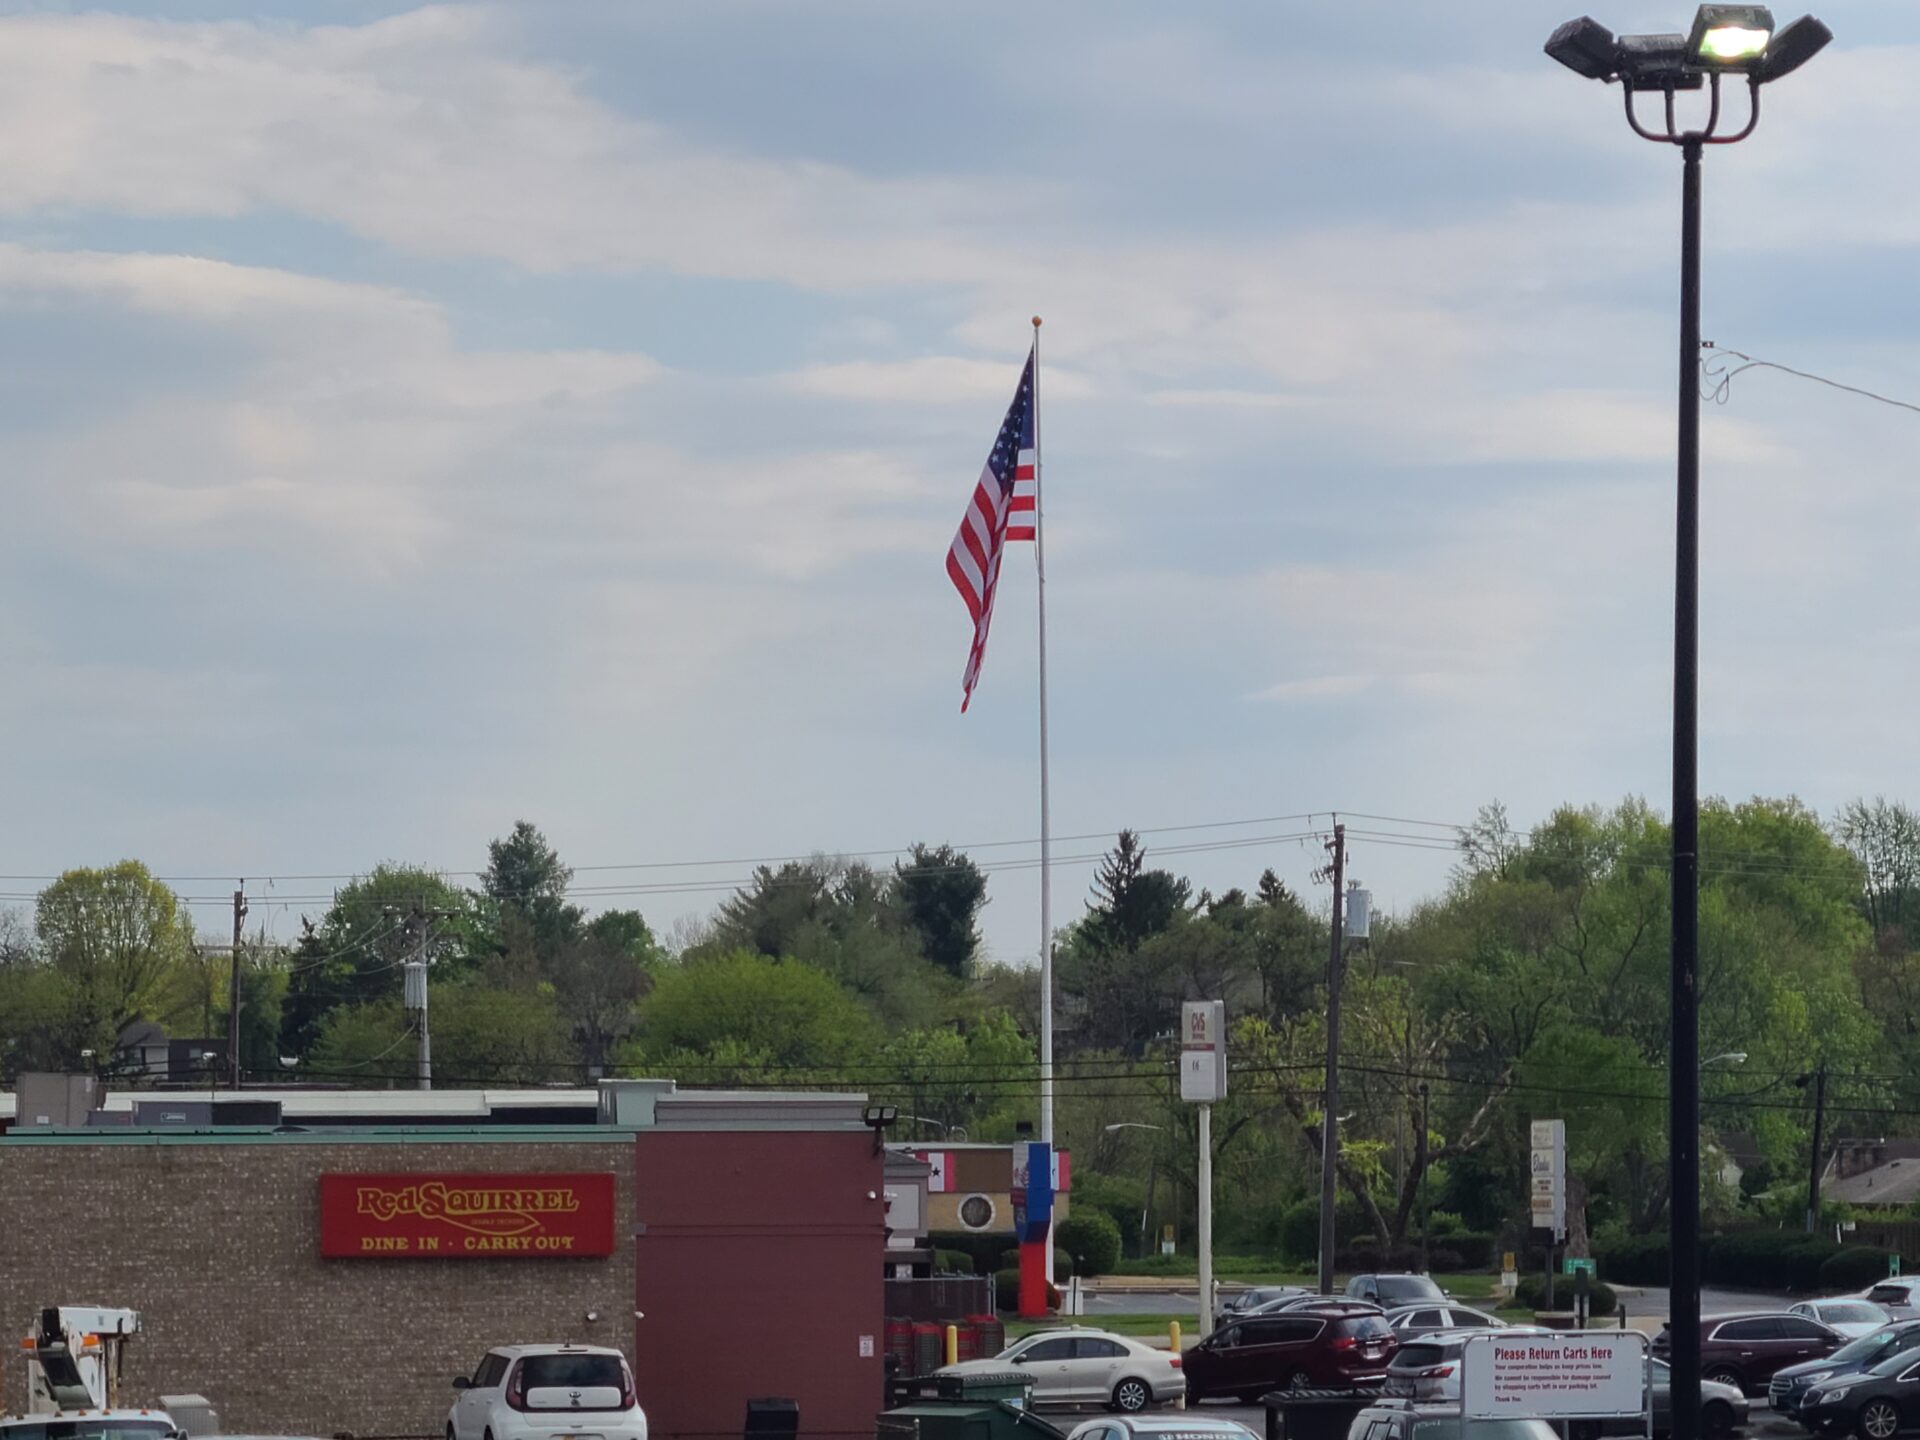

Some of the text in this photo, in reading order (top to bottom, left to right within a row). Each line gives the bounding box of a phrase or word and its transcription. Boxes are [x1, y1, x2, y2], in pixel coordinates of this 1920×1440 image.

[357, 1187, 418, 1220] Red
[361, 1236, 409, 1250] DINE
[418, 1236, 439, 1250] IN
[1495, 1347, 1612, 1360] Please Return Carts Here
